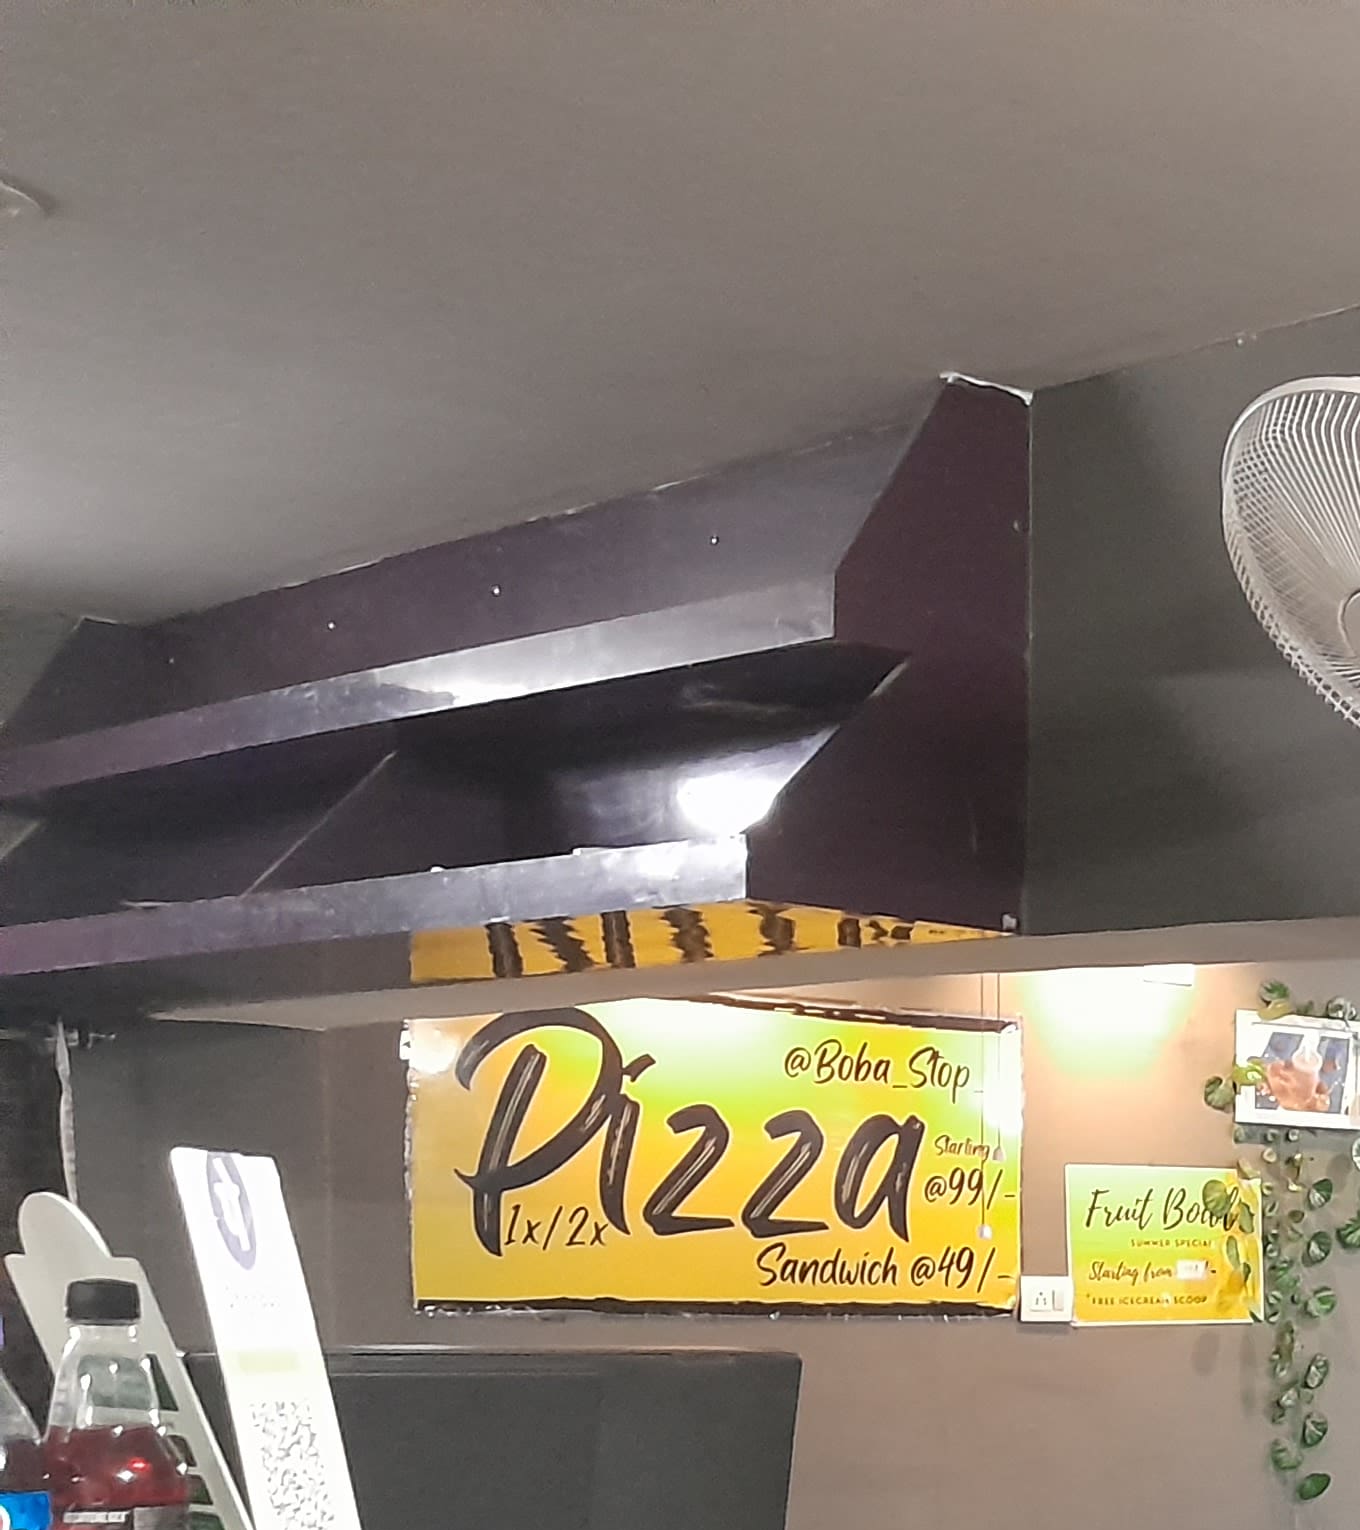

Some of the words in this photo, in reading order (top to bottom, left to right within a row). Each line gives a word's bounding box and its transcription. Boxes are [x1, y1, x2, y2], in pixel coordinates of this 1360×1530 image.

[454, 1007, 925, 1257] Pizza
[934, 1134, 990, 1163] Starting
[924, 1167, 1016, 1210] @99/-
[1085, 1187, 1154, 1231] Fruit
[756, 1242, 898, 1287] Sandwich
[911, 1246, 1015, 1293] @49/-
[1088, 1261, 1139, 1286] Starting
[1143, 1261, 1173, 1283] from
